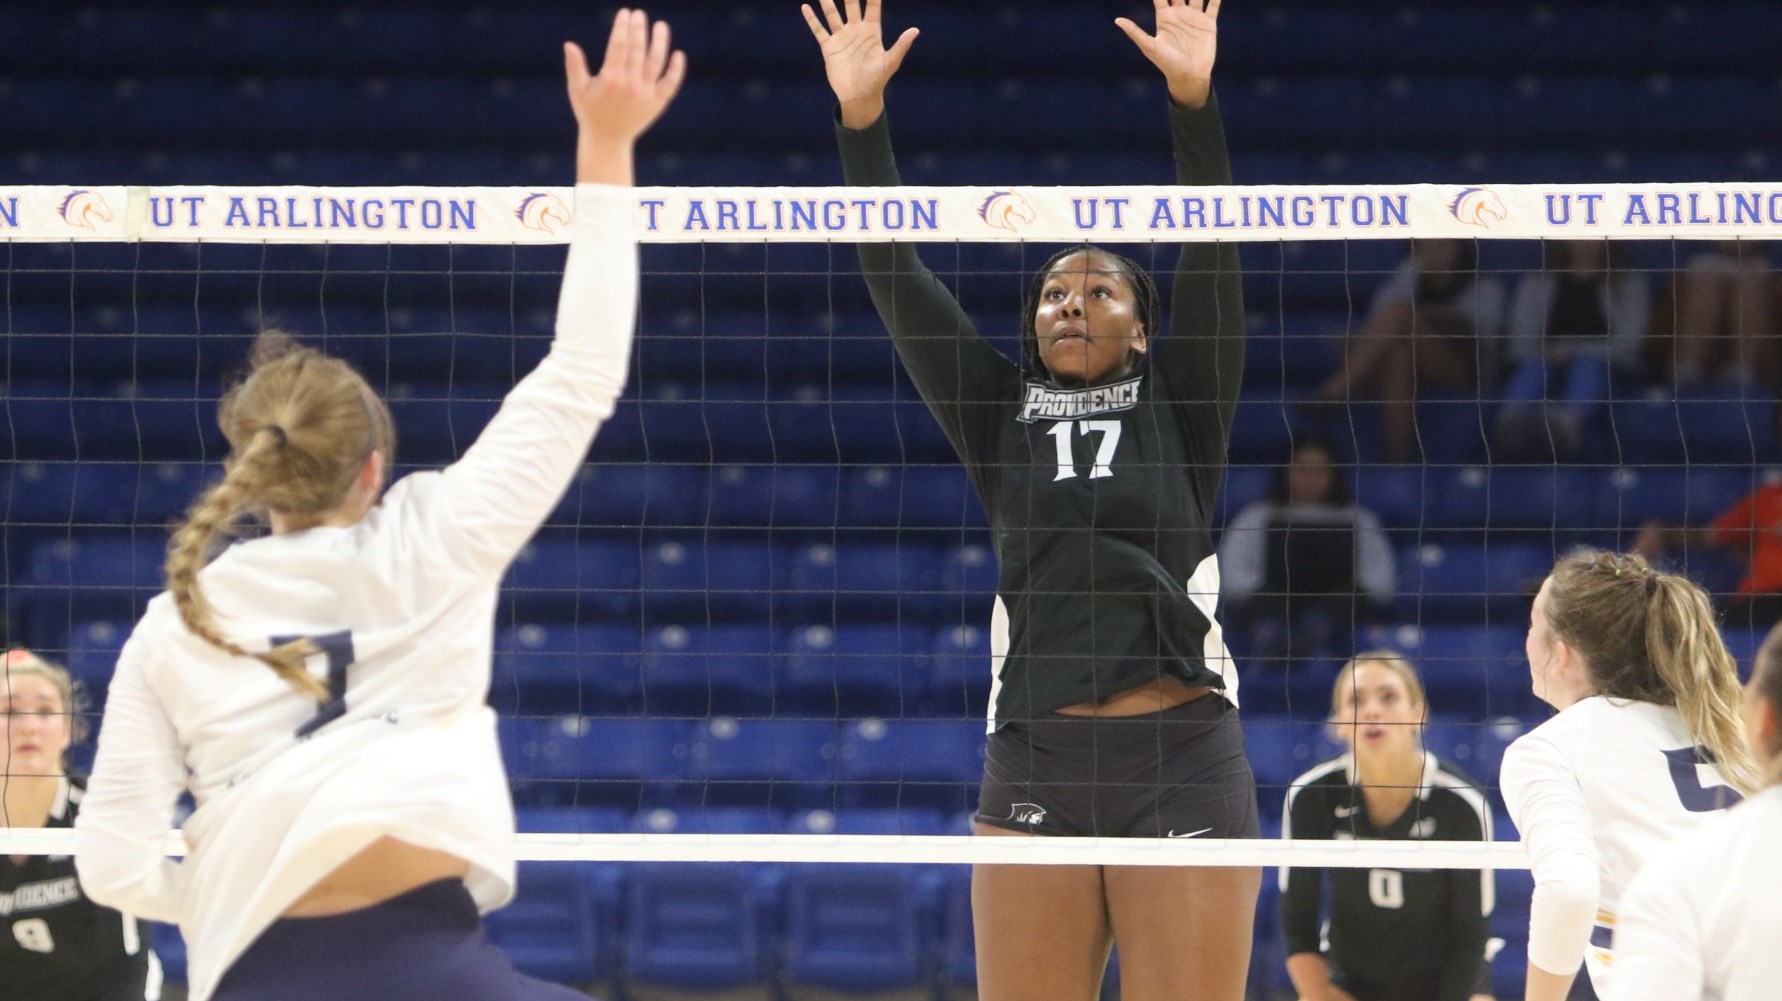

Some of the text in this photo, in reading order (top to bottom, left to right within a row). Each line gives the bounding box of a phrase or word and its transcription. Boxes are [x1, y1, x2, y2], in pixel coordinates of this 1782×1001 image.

[150, 196, 478, 230] UT ARLINGTON
[639, 199, 940, 231] T ARLINGTON
[1072, 194, 1410, 230] UT ARLINGTON
[1544, 192, 1604, 226] UT
[1018, 378, 1142, 422] PROVIDENCE
[1046, 420, 1122, 481] 17
[267, 628, 355, 738] 7
[1367, 867, 1405, 910] 0
